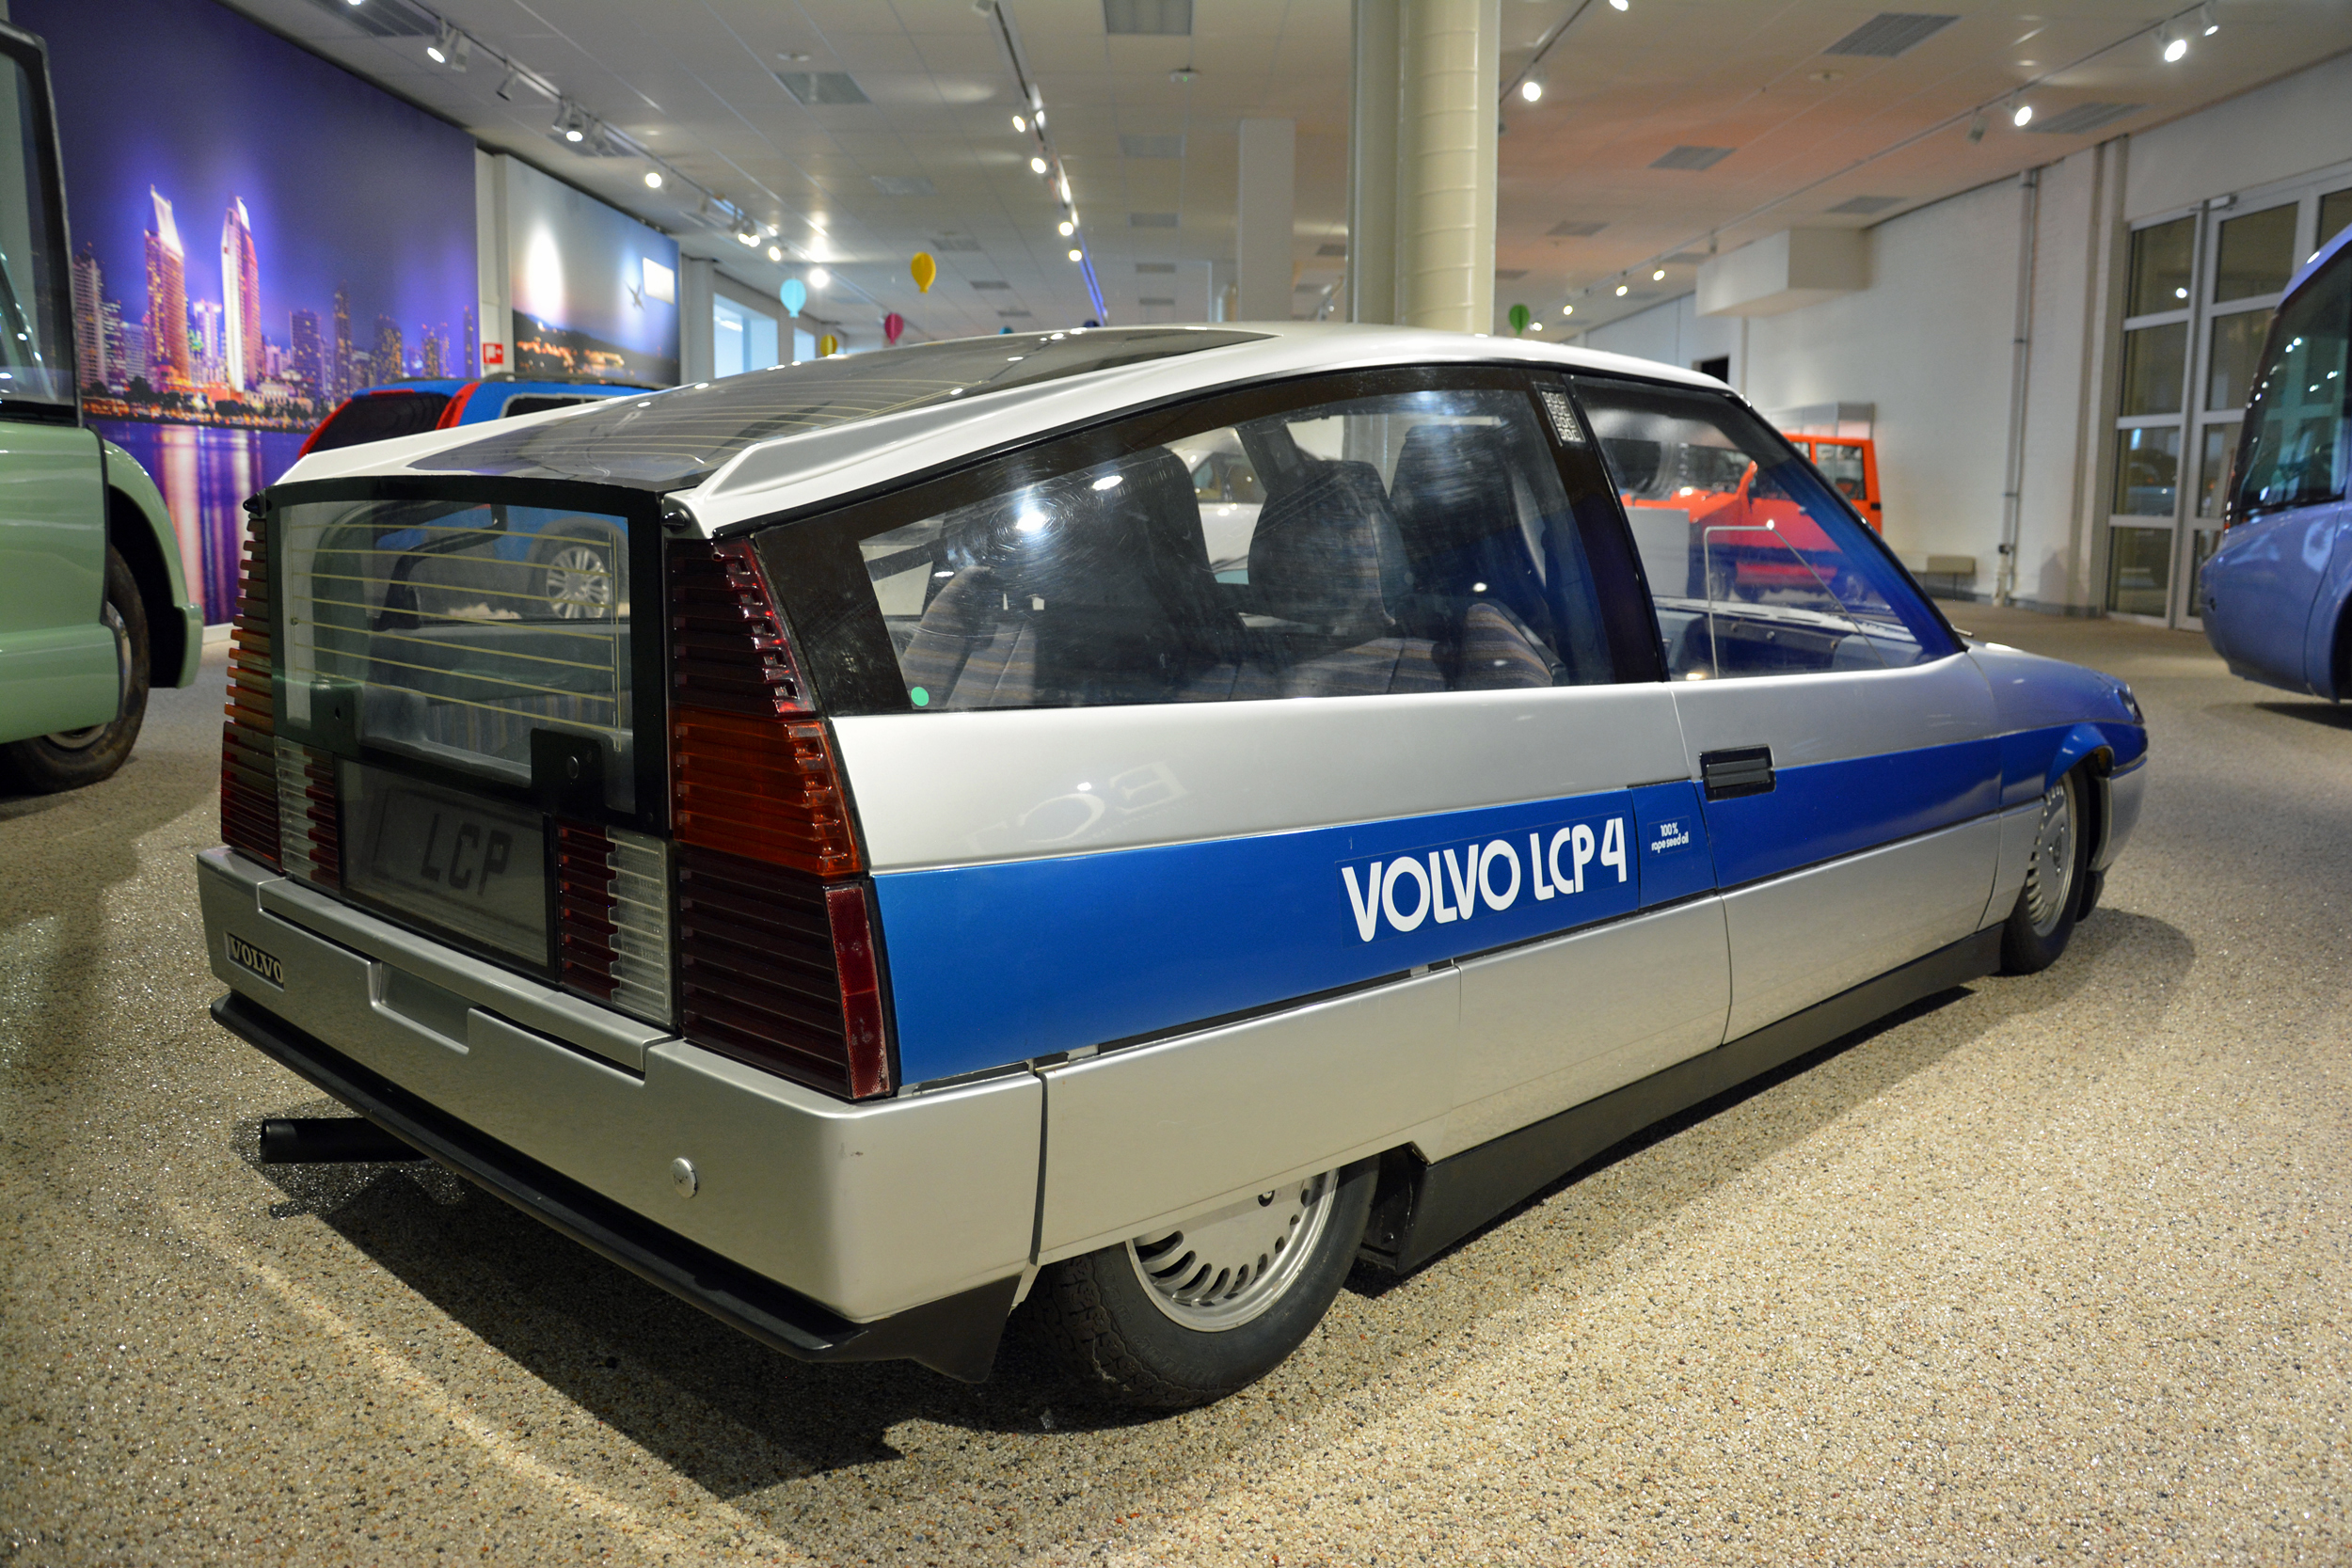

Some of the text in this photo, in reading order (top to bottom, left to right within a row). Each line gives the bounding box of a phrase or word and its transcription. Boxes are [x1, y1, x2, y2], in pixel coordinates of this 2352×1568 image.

[420, 812, 515, 896] LCP
[1666, 832, 1681, 848] seed
[1681, 831, 1690, 845] oil
[1342, 816, 1628, 942] VOLVO LCP 4
[230, 937, 284, 984] VOLVO
